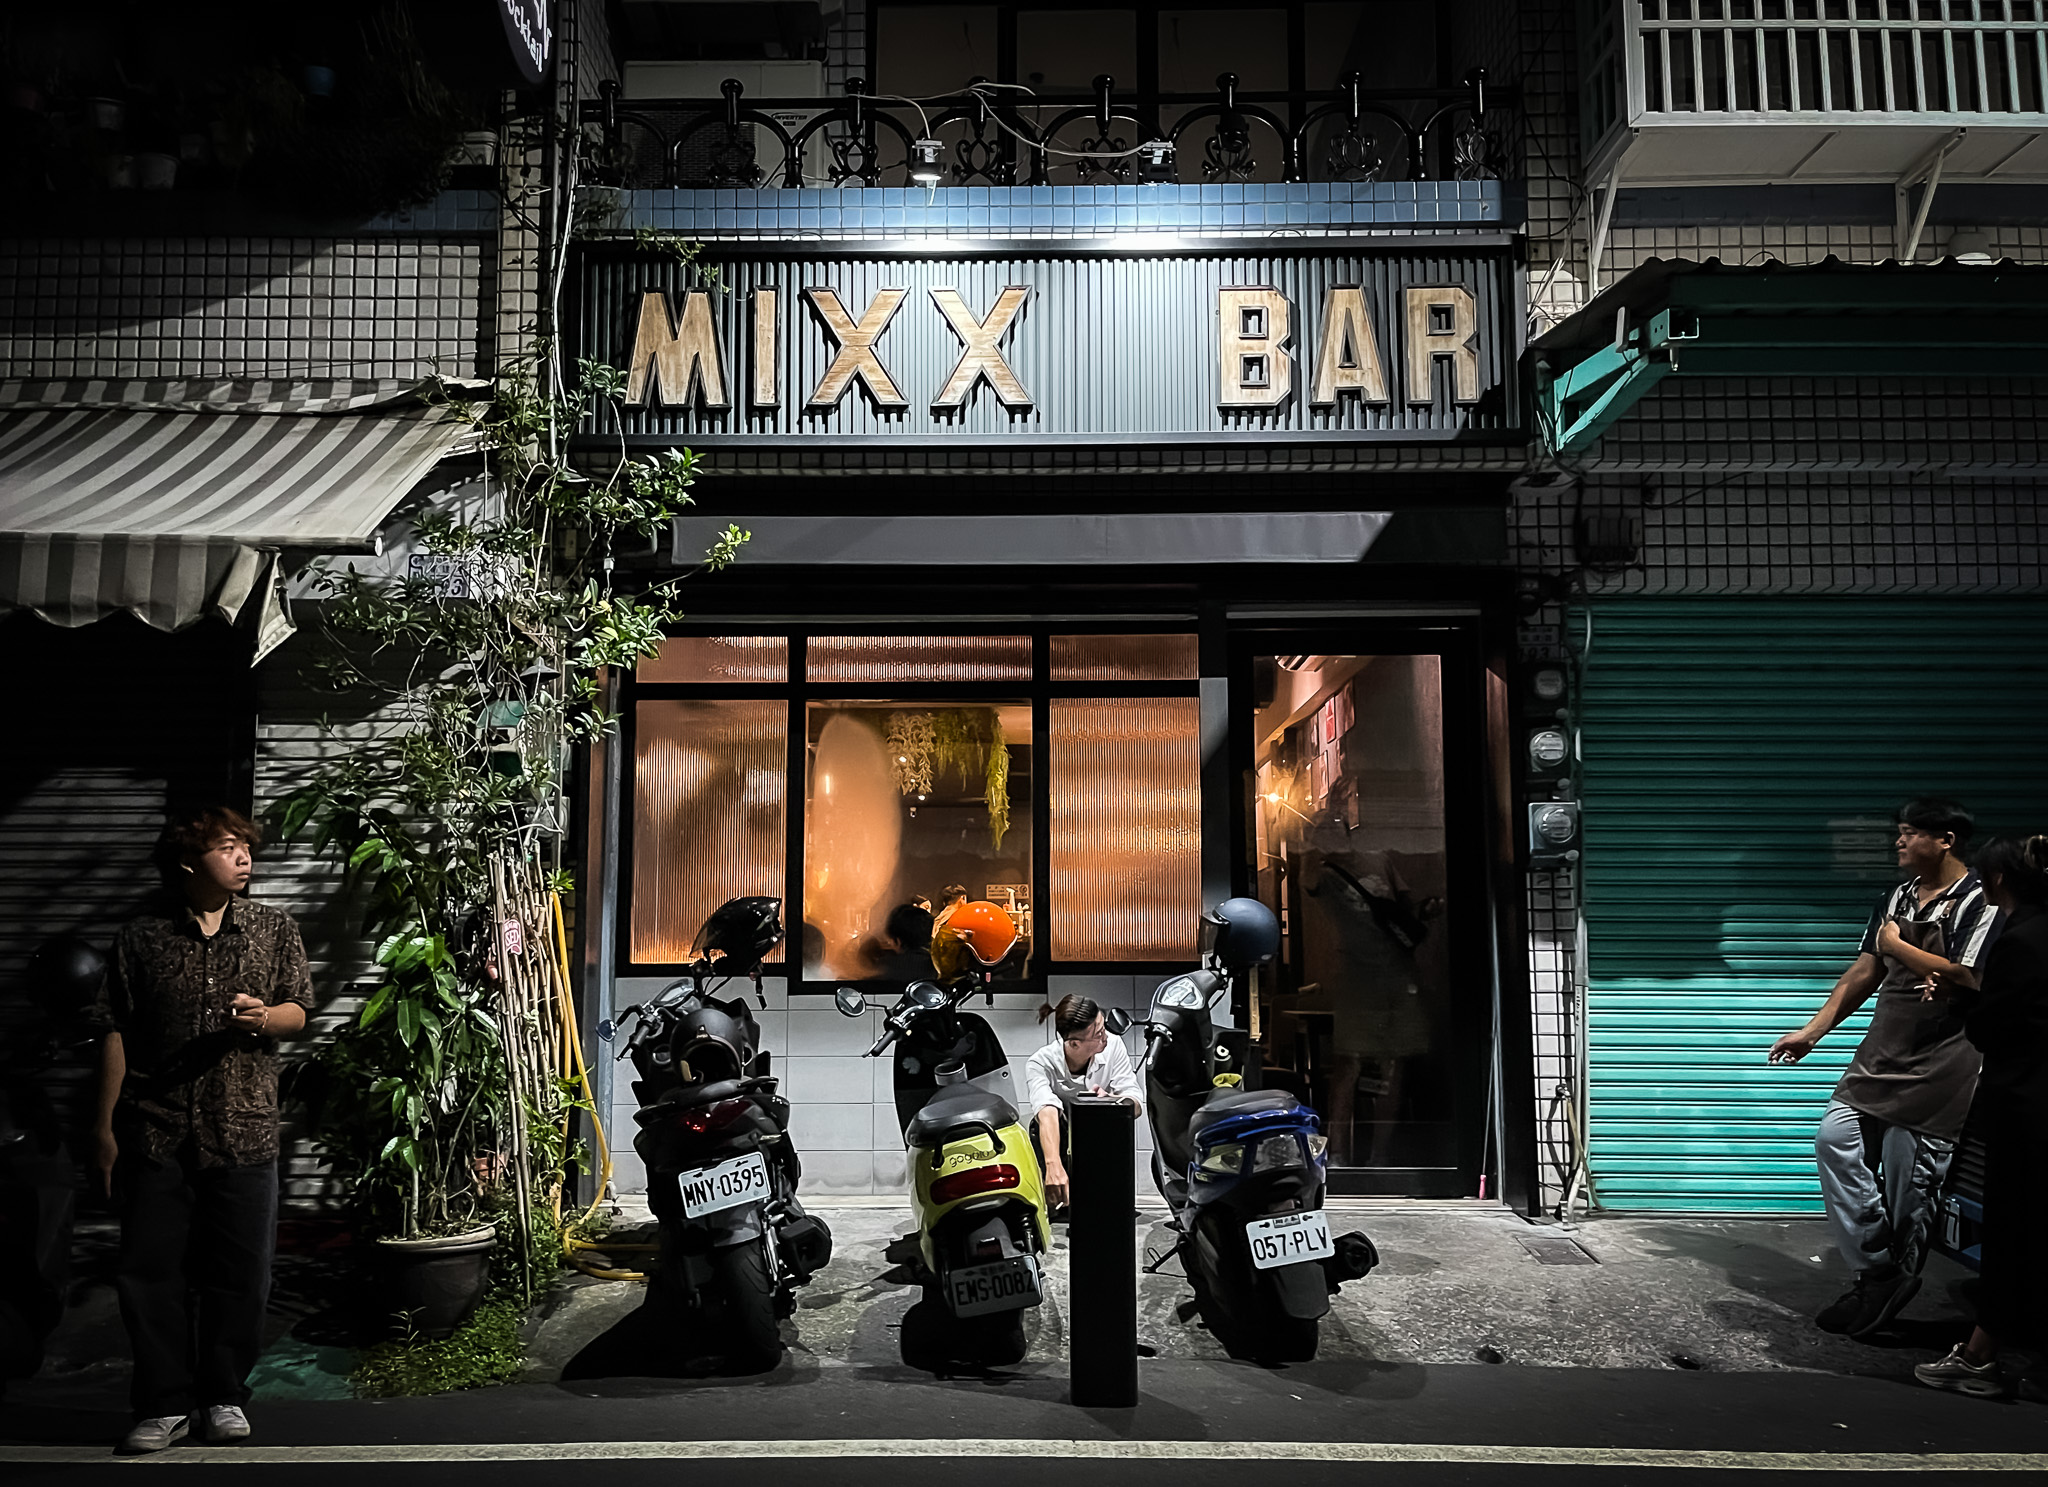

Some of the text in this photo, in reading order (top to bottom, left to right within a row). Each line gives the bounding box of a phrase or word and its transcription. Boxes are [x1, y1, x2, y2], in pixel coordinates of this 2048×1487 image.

[503, 0, 542, 72] ocktail
[622, 284, 1481, 409] MIXX BAR
